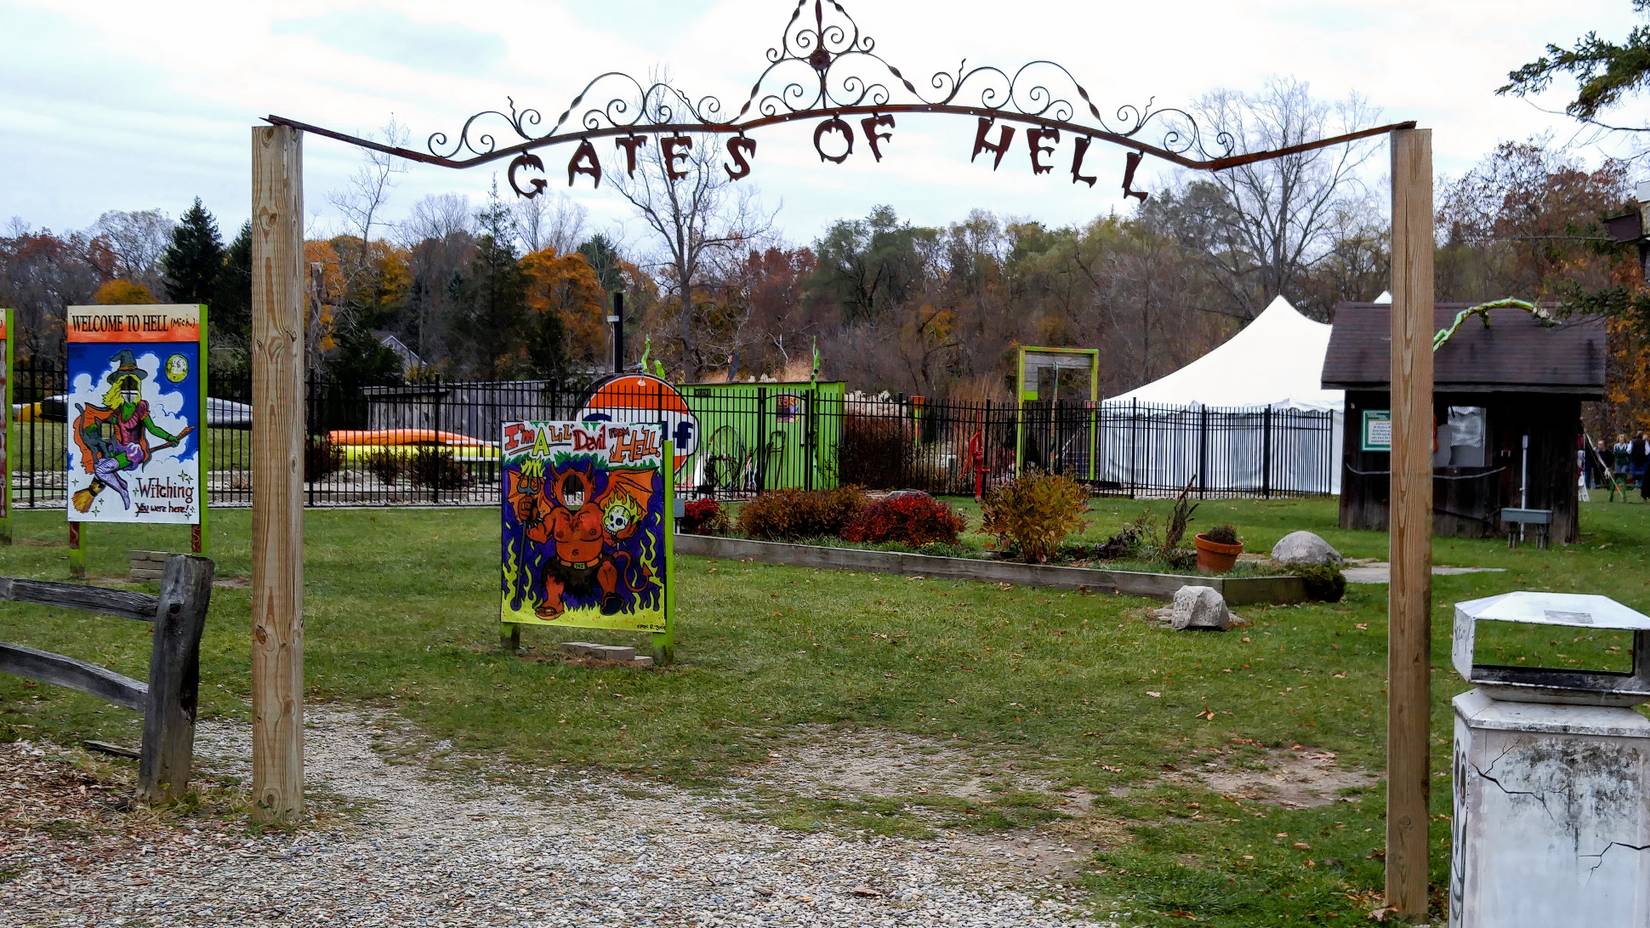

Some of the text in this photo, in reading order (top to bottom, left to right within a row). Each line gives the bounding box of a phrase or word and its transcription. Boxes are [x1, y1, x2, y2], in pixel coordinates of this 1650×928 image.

[507, 113, 1149, 203] GATES OF HELL
[72, 314, 124, 332] WELCOME
[126, 314, 140, 332] TO
[142, 314, 169, 332] HELL
[504, 423, 535, 451] I'm
[532, 427, 550, 457] A
[135, 476, 194, 504] Witching
